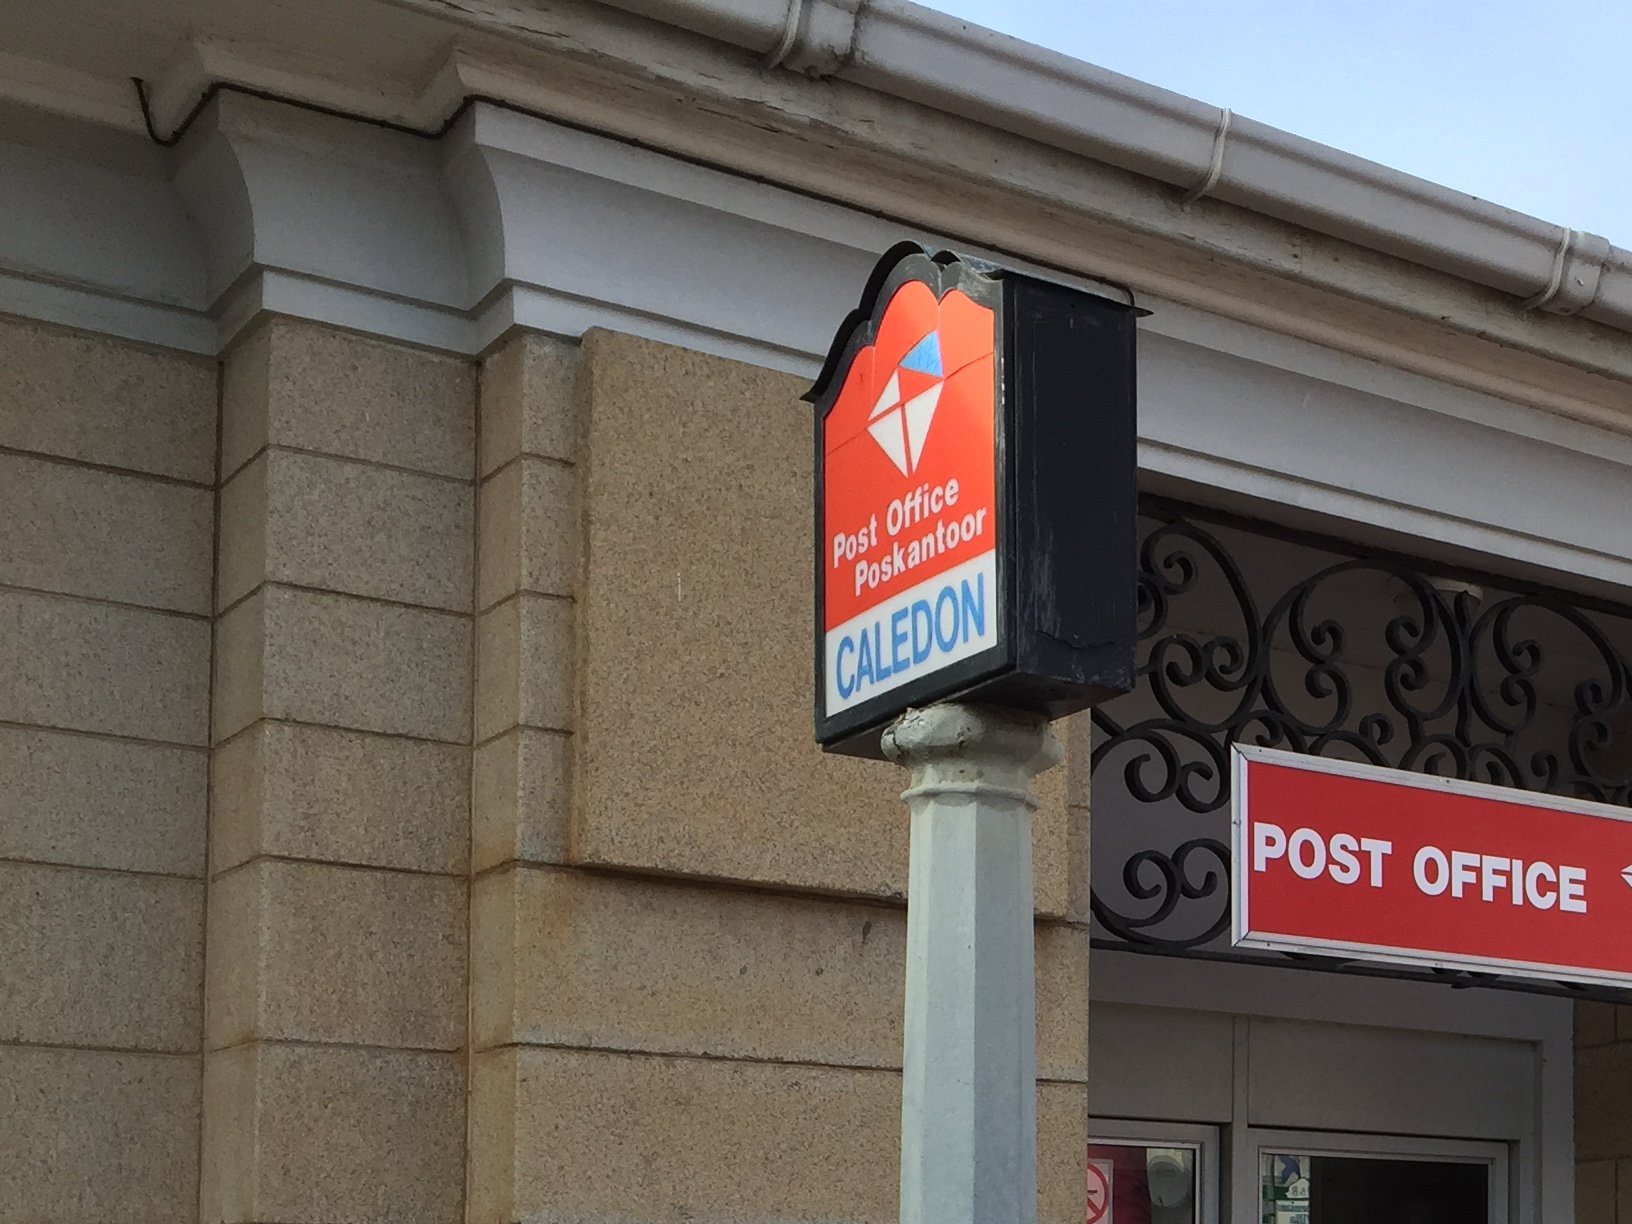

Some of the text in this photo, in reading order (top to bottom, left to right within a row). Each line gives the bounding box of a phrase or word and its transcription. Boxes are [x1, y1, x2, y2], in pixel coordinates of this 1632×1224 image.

[833, 479, 959, 567] Post Office
[855, 508, 987, 596] Poskantoor
[837, 573, 984, 698] CALEDON
[1254, 822, 1587, 913] POST OFFICE
